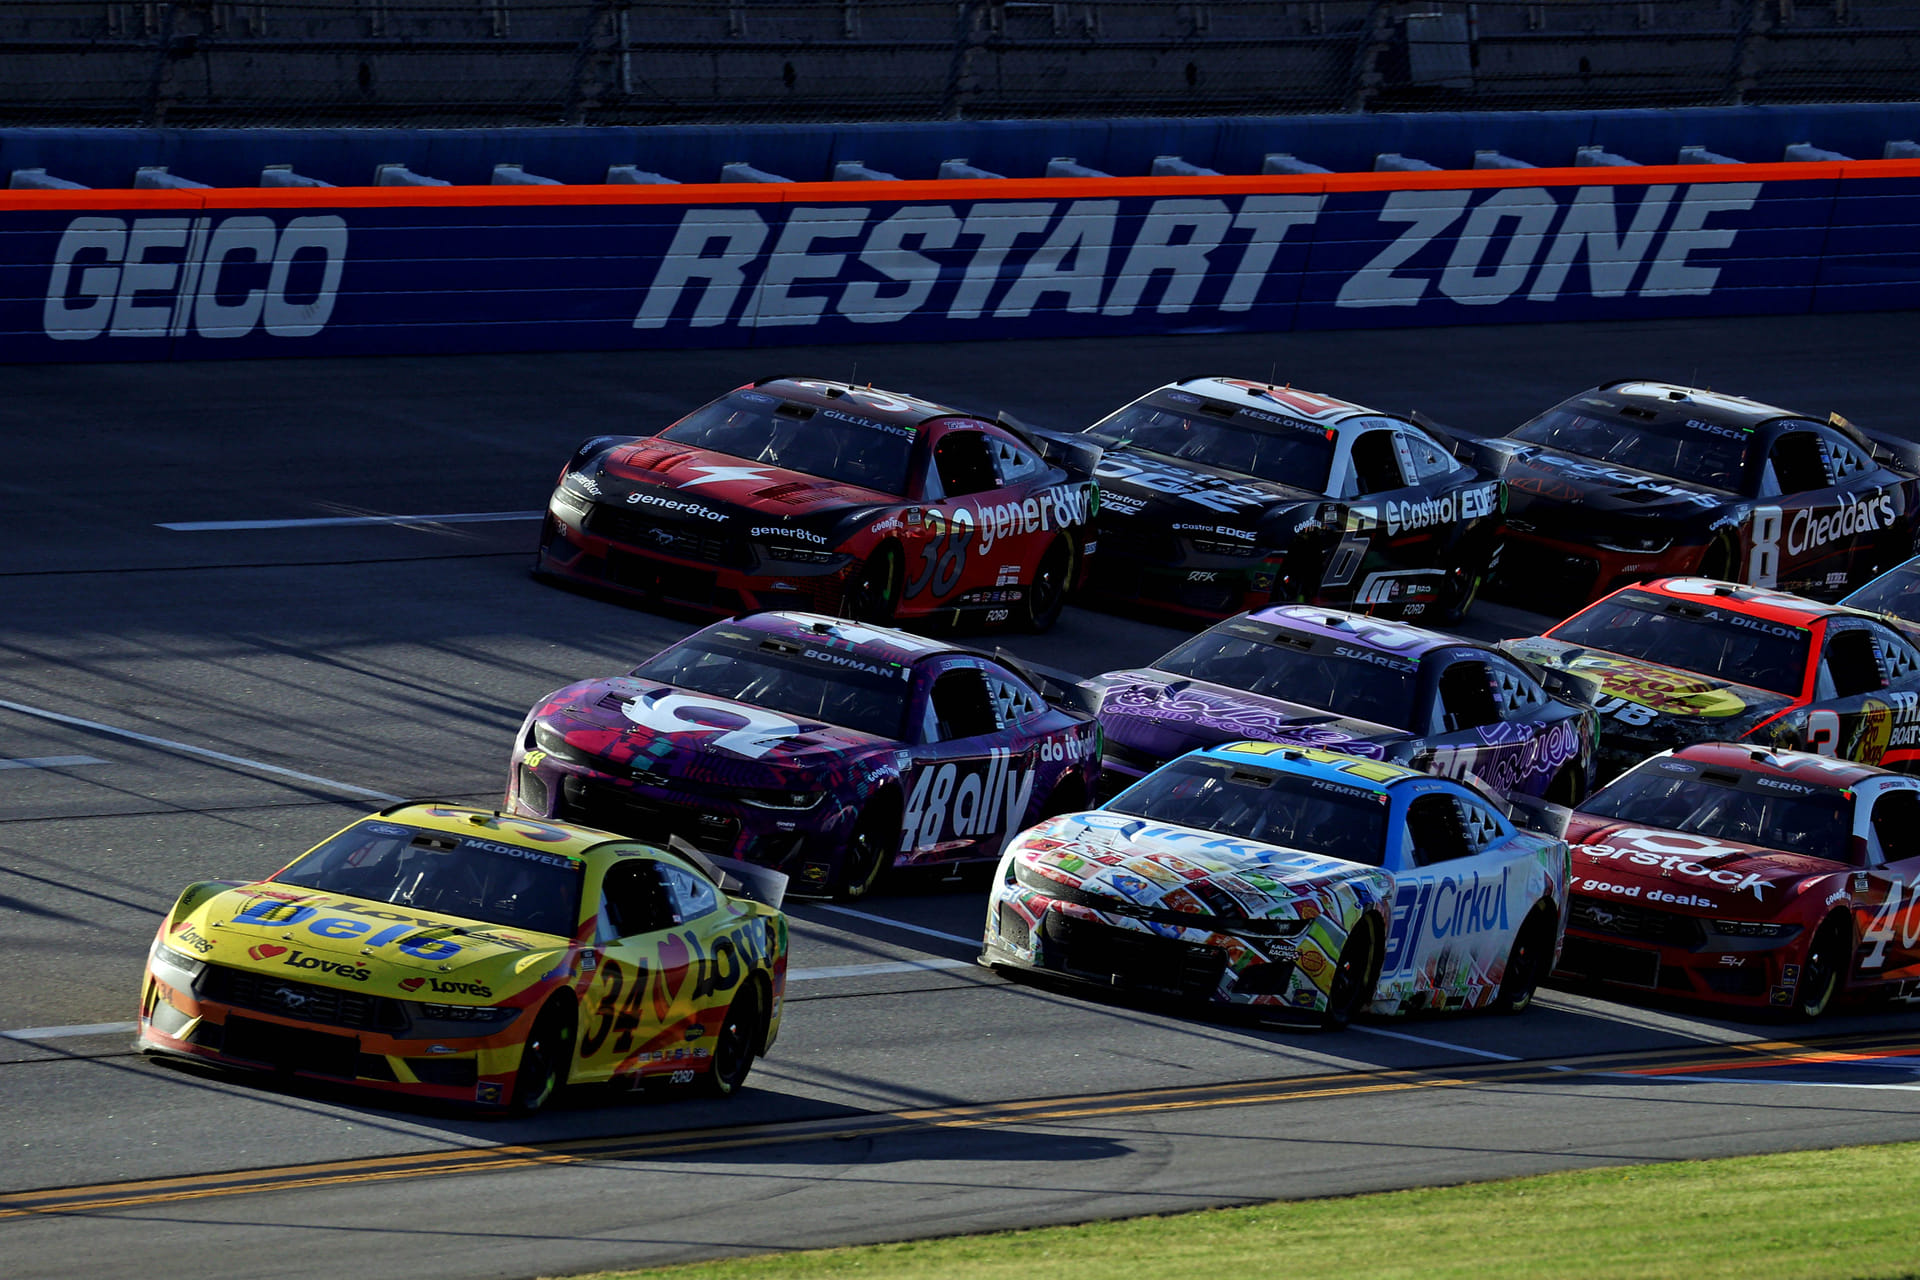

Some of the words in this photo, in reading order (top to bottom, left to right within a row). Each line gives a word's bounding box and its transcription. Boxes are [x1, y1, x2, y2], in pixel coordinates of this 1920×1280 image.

[632, 194, 1328, 330] RESTART
[1335, 182, 1763, 308] ZONE
[43, 215, 348, 341] GEICO
[823, 409, 908, 438] GILLILAND
[1238, 408, 1327, 436] KESELOWSK
[1686, 419, 1748, 442] BUSCH
[1094, 460, 1264, 514] DGE
[626, 491, 730, 523] gener8tor
[1400, 490, 1458, 533] Castrol
[1461, 482, 1498, 520] EDGE
[1787, 485, 1896, 556] Cheddar's
[750, 525, 828, 546] gener8tor
[1181, 523, 1214, 532] Castrol
[1215, 526, 1258, 541] EDGE
[1746, 505, 1783, 589] 8
[904, 508, 974, 598] 38
[1402, 603, 1425, 616] FORD
[1703, 611, 1724, 623] A.
[1729, 614, 1802, 642] DILLON
[803, 650, 895, 679] BOWMAN
[1889, 692, 1920, 724] TR
[1041, 735, 1064, 762] do
[1807, 709, 1840, 760] 3
[523, 750, 547, 768] 48
[1311, 780, 1380, 802] HEMRIC
[1756, 776, 1816, 795] BERRY
[900, 763, 958, 853] 48
[954, 747, 1035, 857] ally
[464, 838, 573, 869] MCDOWELL
[1568, 843, 1777, 903] erstock
[1431, 866, 1509, 940] Cirkul
[1582, 877, 1642, 898] good
[1646, 887, 1719, 909] deals.
[231, 900, 462, 960] Delo
[580, 957, 649, 1058] 34
